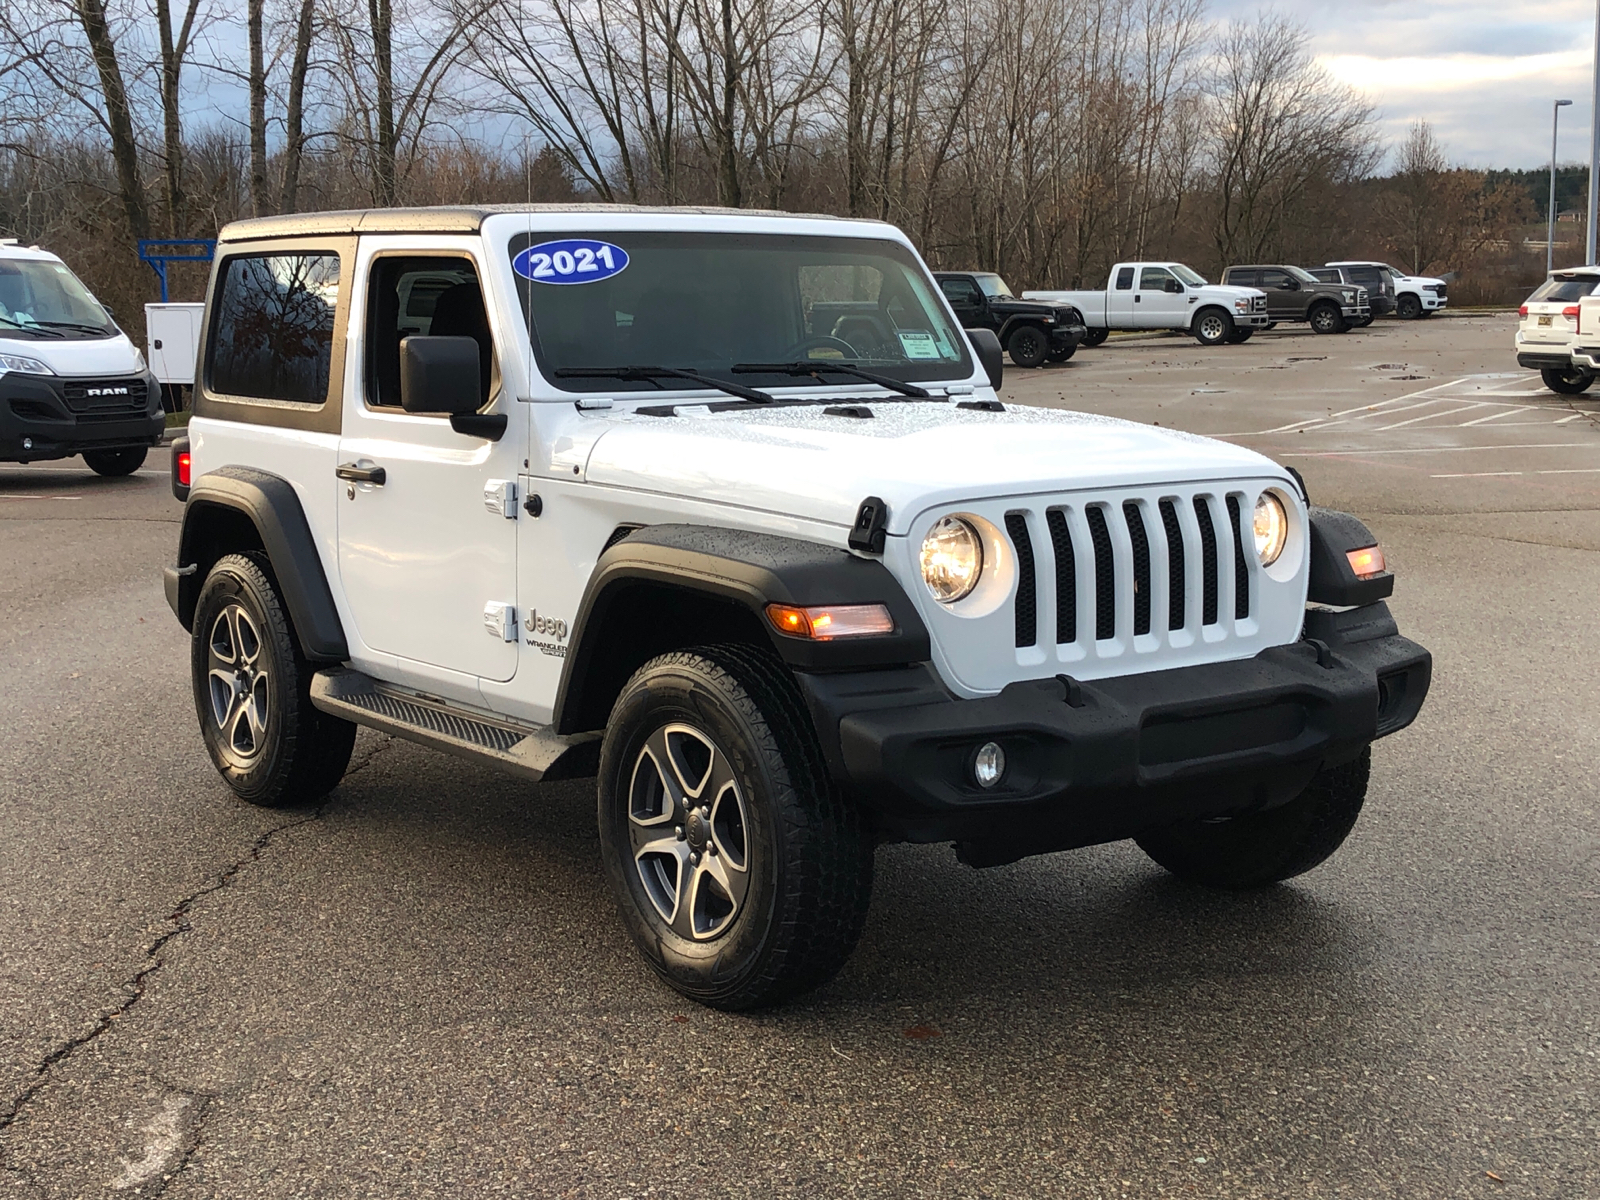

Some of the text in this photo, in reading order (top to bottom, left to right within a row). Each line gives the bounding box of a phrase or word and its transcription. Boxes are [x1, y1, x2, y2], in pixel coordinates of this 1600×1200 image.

[530, 245, 615, 278] 2021
[87, 387, 128, 396] RAM
[524, 607, 567, 642] Jeep
[526, 638, 567, 651] WRANGLER
